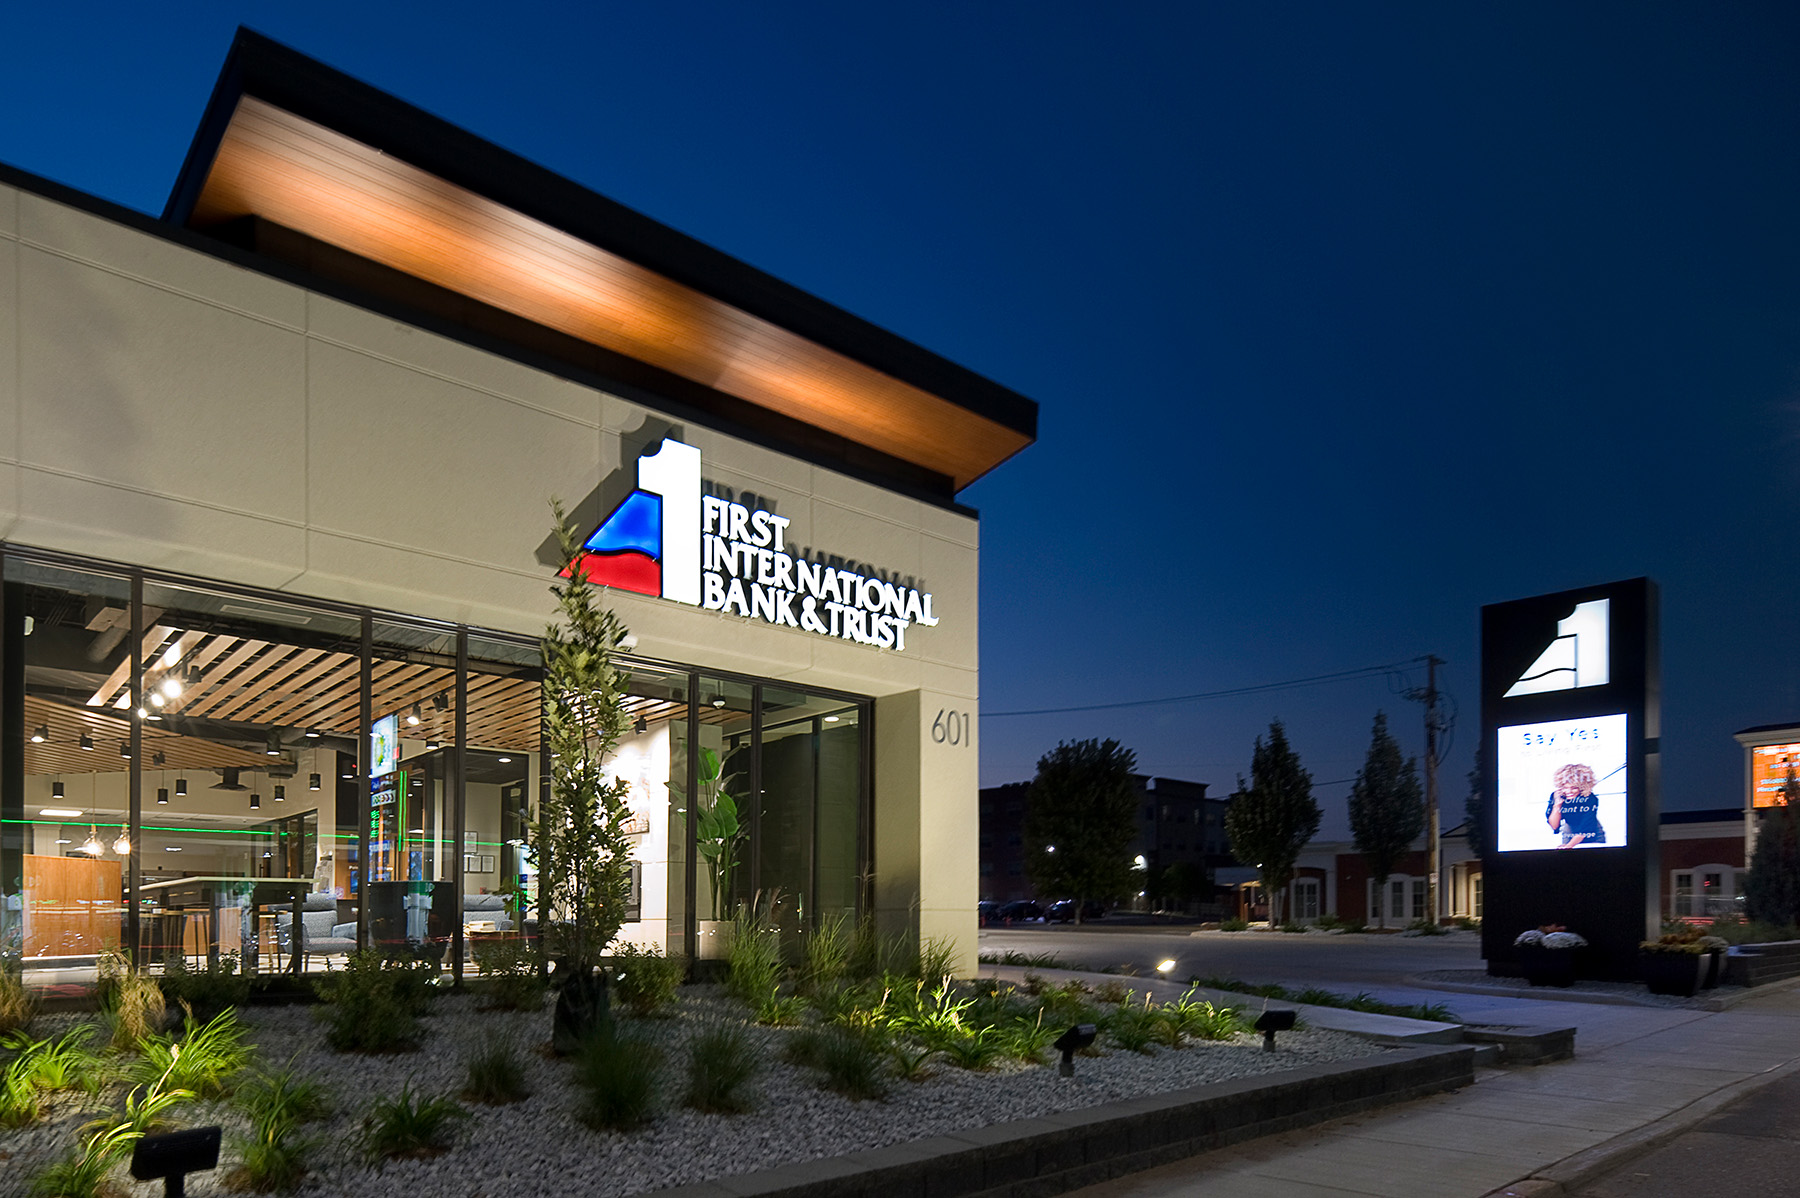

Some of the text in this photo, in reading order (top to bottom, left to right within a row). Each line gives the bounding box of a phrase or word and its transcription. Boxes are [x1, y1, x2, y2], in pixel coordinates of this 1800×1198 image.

[702, 495, 790, 552] FIRST
[703, 533, 940, 627] INTERNATIONAL
[703, 571, 910, 651] BANK & TRUST
[931, 708, 970, 748] 601
[1522, 728, 1599, 746] Say Yes
